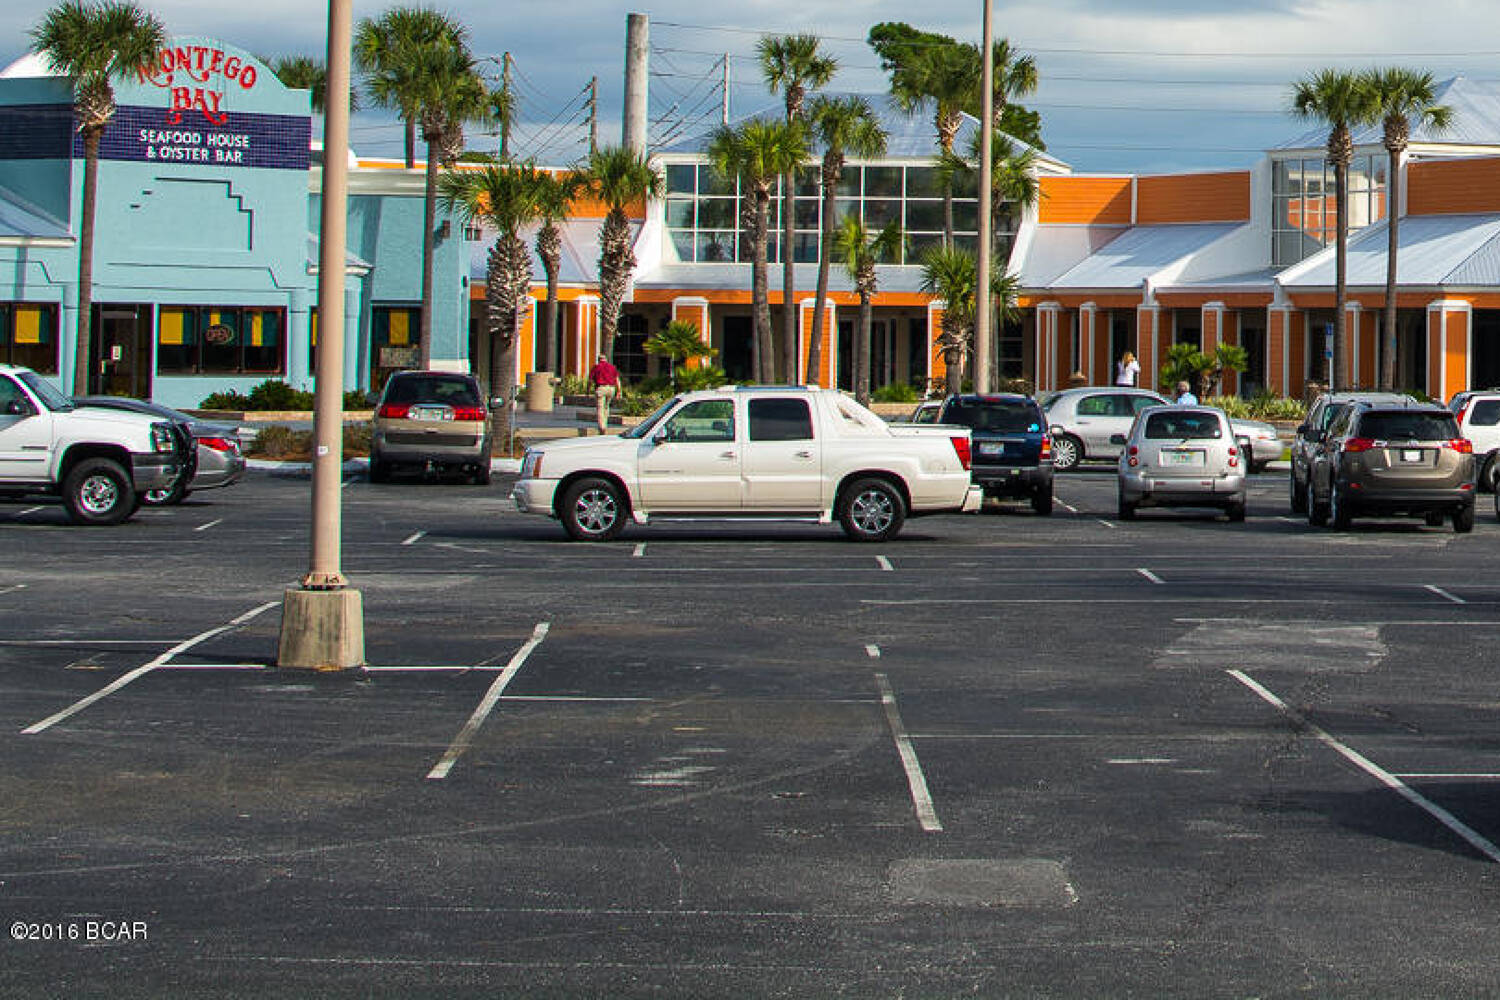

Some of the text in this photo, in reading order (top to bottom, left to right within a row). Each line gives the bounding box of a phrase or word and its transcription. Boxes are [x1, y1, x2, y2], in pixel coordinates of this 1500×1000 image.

[167, 86, 228, 126] BAY
[139, 130, 250, 148] SEAFOOD HOUSE
[147, 146, 243, 163] & OYSTER BAR
